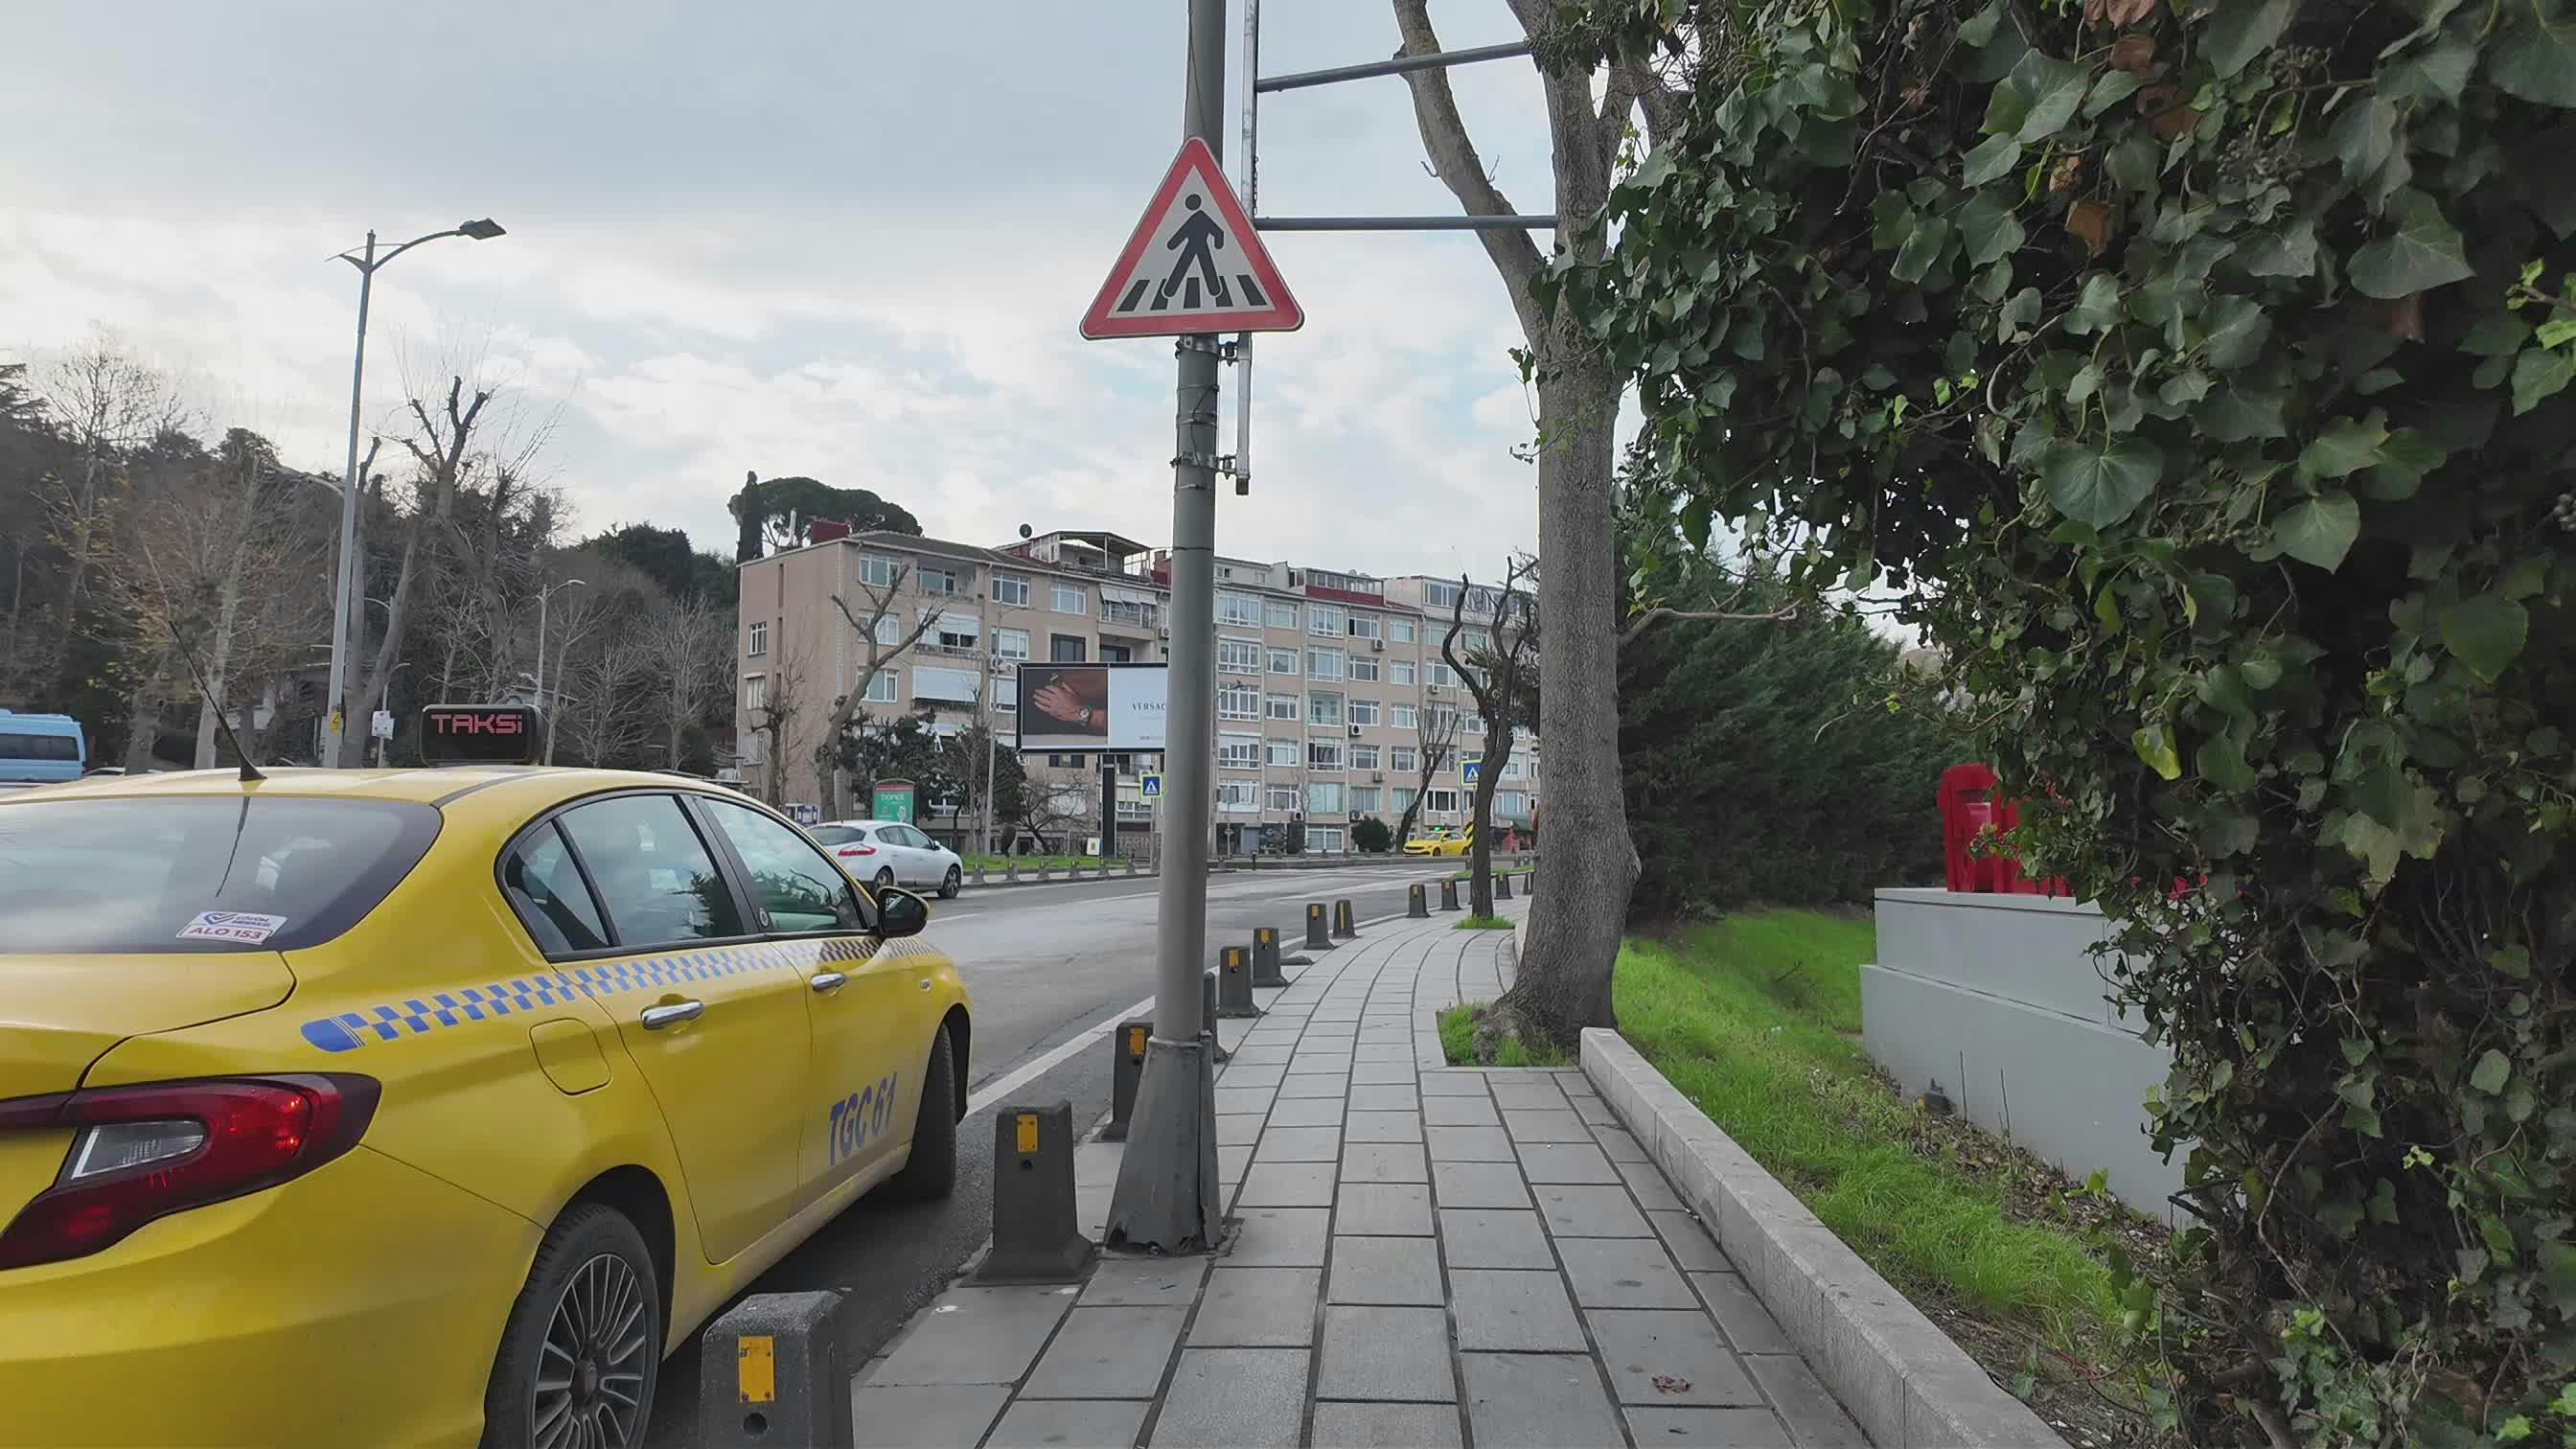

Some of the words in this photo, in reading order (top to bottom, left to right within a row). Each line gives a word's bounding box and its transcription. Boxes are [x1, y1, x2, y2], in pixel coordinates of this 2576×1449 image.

[1131, 702, 1166, 711] VERSAC
[189, 927, 230, 936] ALO
[234, 929, 264, 939] 153
